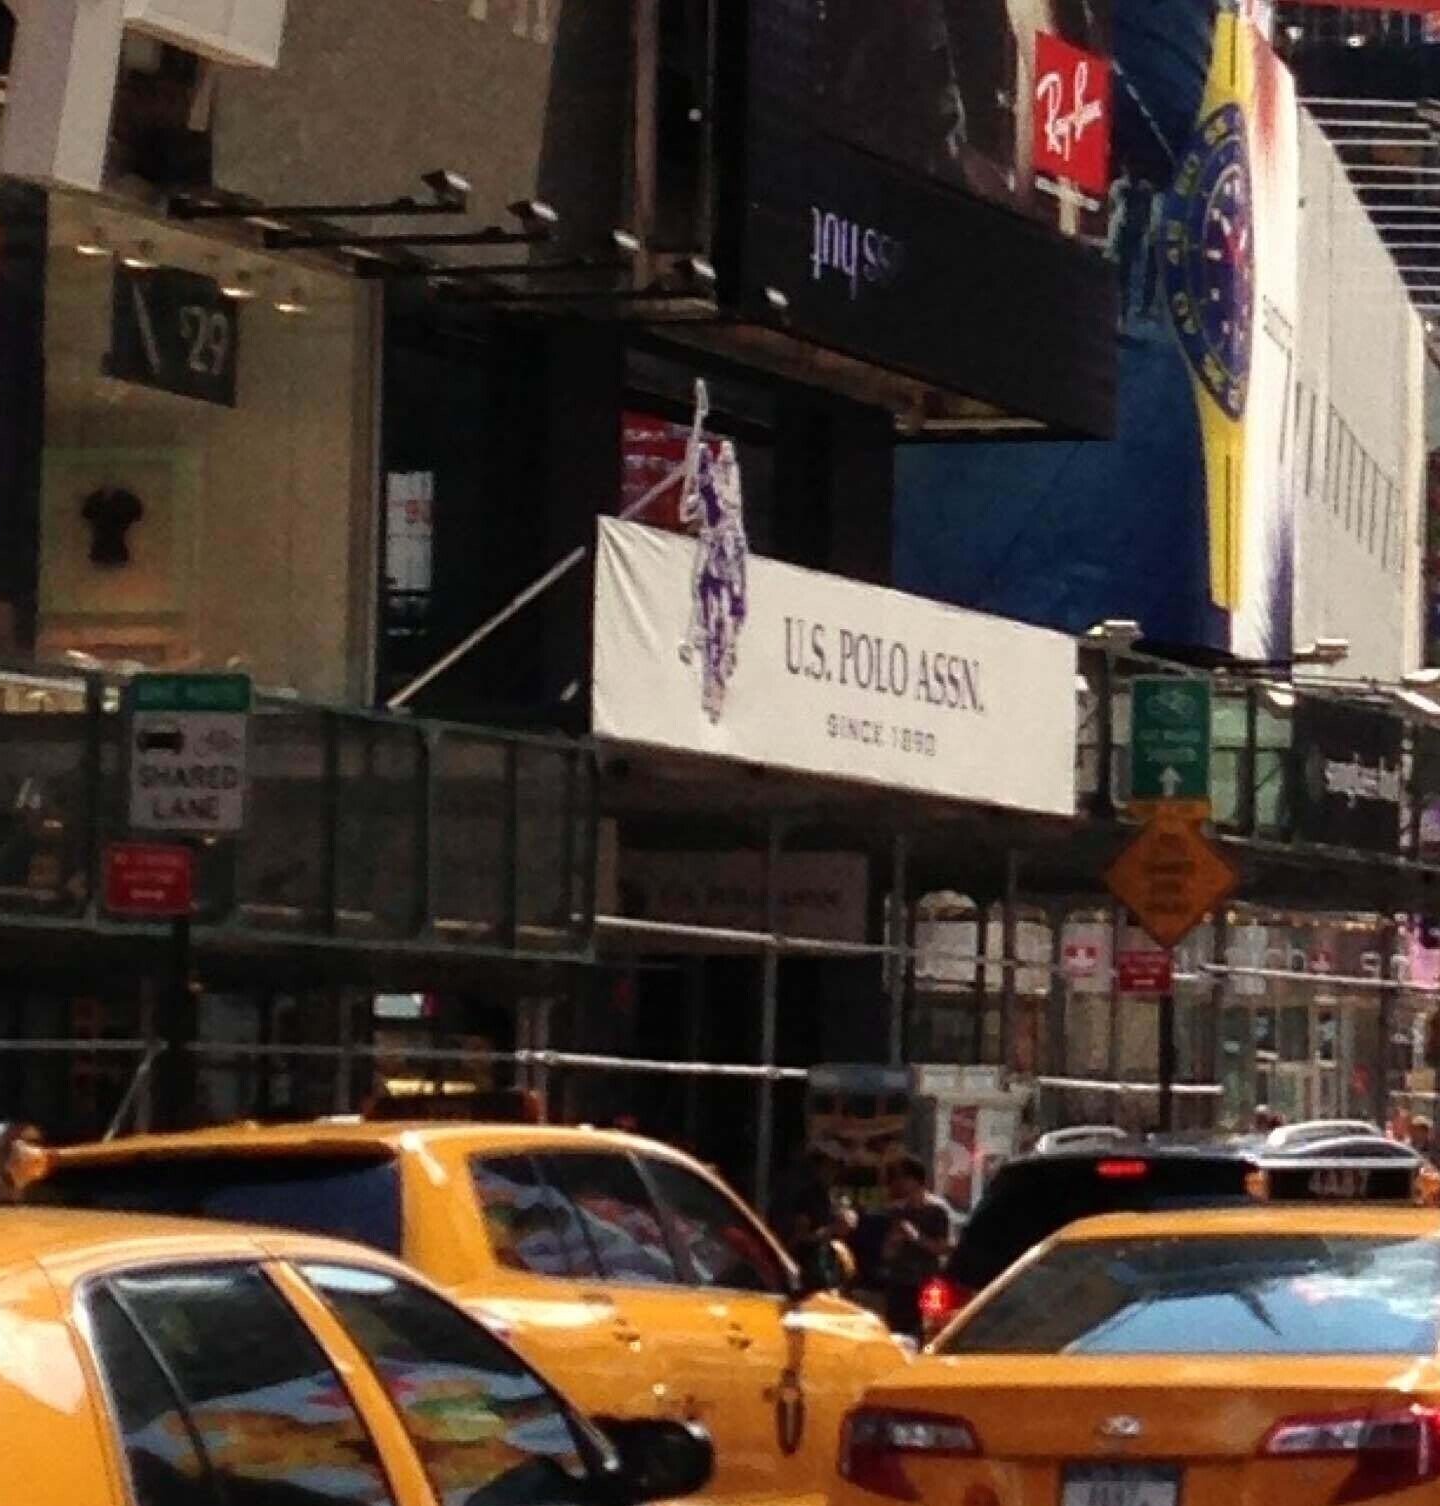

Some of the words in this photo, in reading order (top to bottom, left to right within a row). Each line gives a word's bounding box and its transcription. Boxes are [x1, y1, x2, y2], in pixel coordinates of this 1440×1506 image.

[784, 616, 832, 682] U.S.
[839, 628, 908, 696] POLO
[916, 649, 985, 712] ASSN.
[826, 713, 883, 747] SINCE
